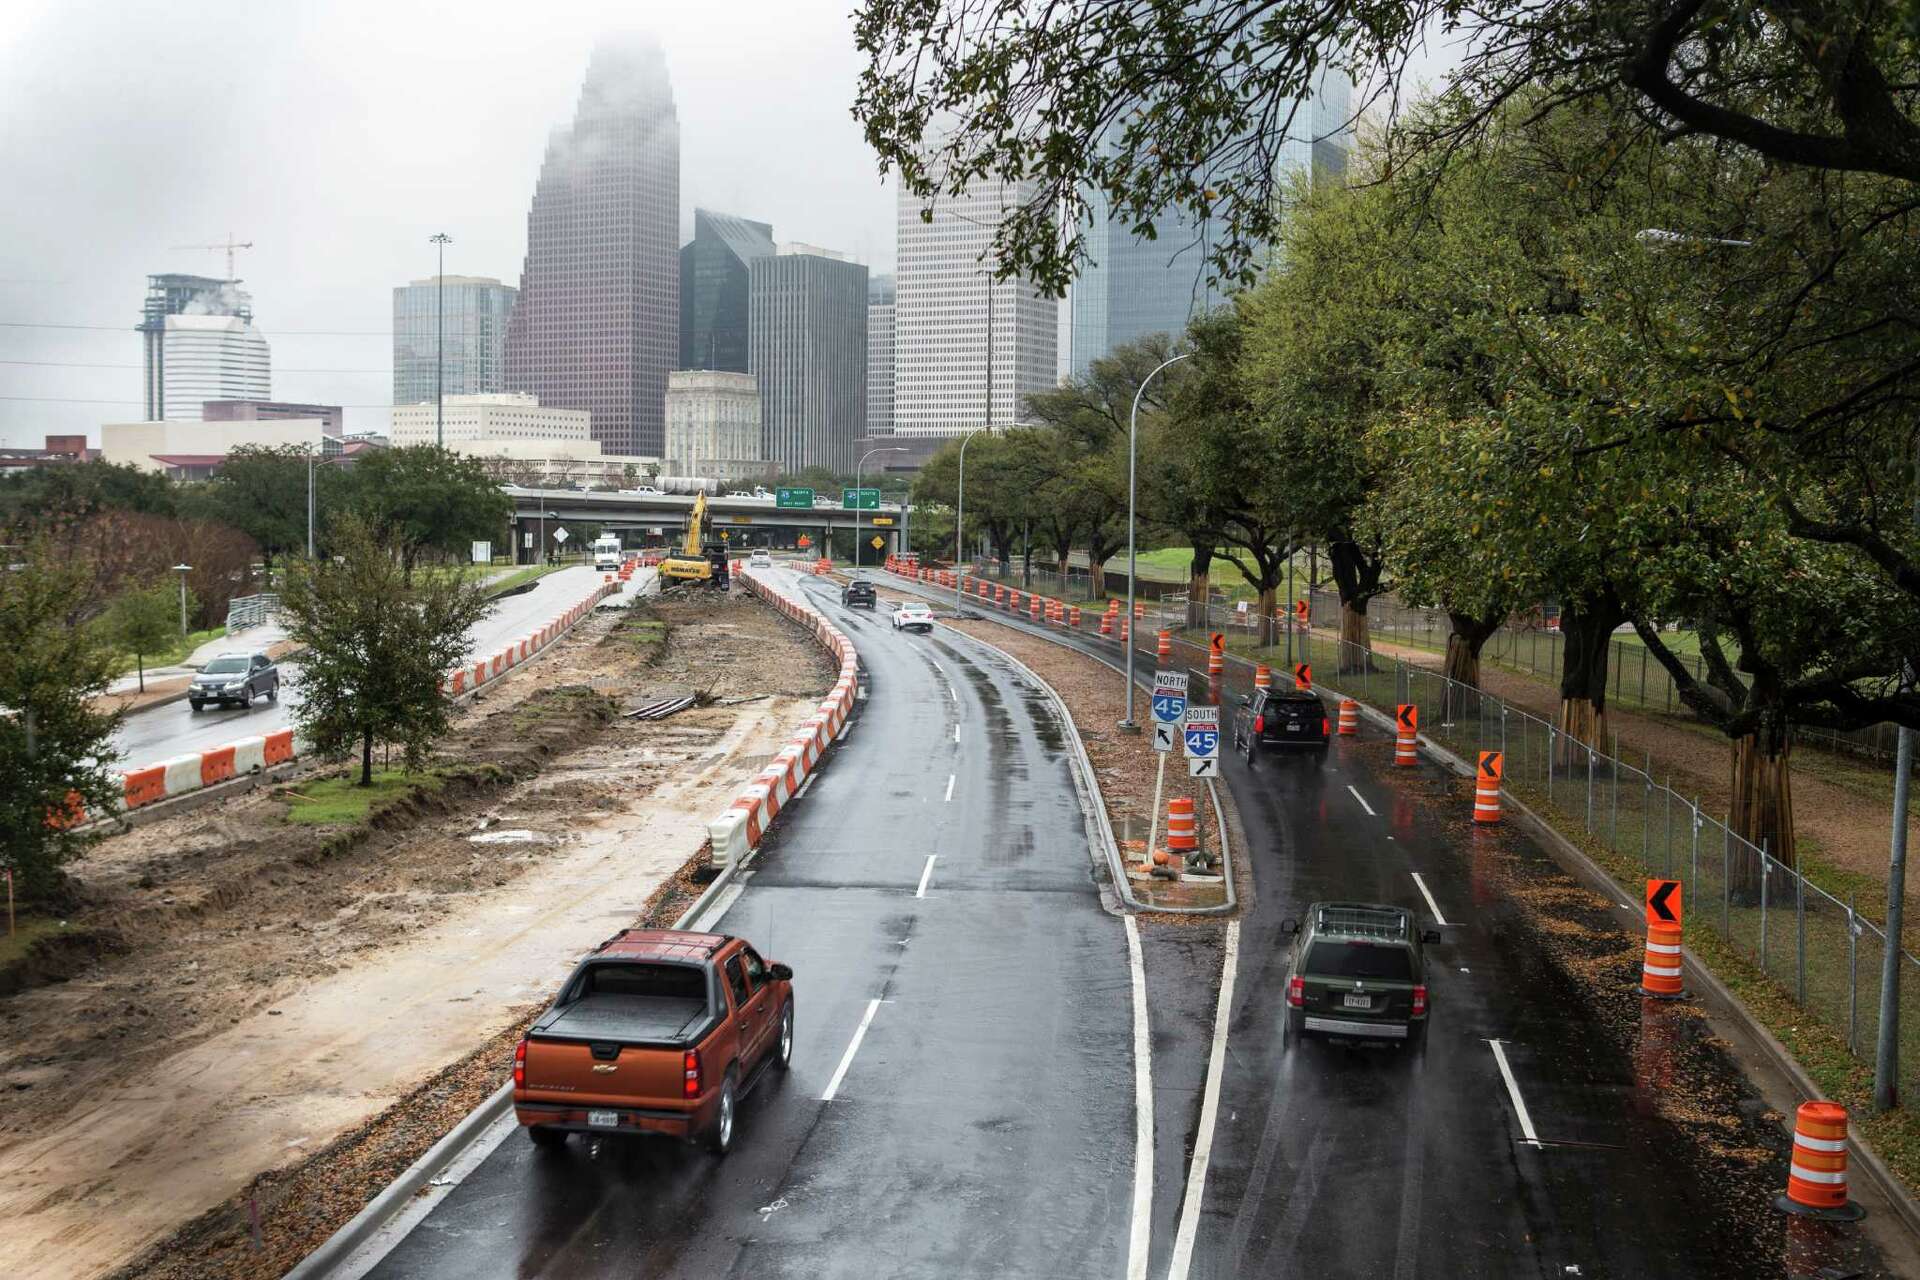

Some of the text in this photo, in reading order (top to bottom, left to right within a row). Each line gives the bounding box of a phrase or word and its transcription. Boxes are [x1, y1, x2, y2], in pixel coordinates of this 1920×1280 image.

[1156, 674, 1187, 687] NORTH
[1154, 698, 1183, 715] 45
[1187, 709, 1217, 720] SOUTH
[1187, 733, 1216, 749] 45
